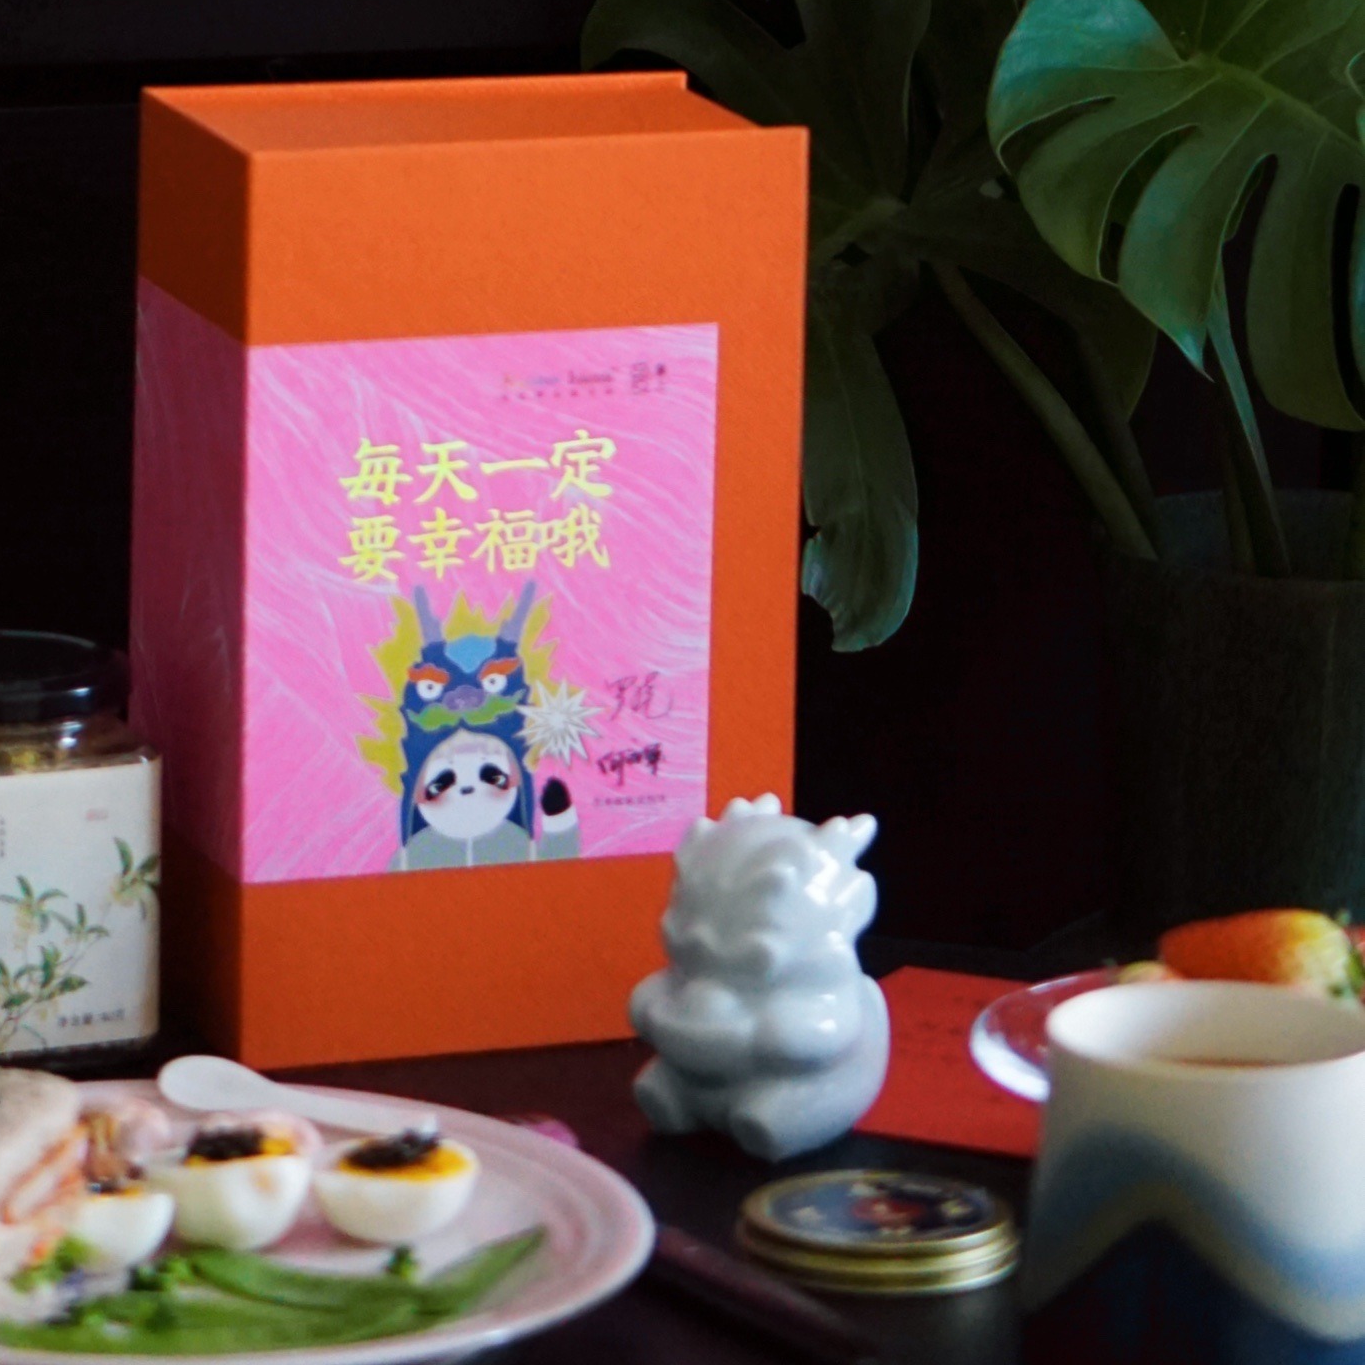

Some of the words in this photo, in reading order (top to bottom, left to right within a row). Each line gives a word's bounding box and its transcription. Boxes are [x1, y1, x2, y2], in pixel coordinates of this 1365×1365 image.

[338, 428, 618, 506] 每天一定
[337, 501, 612, 582] 要幸福哦
